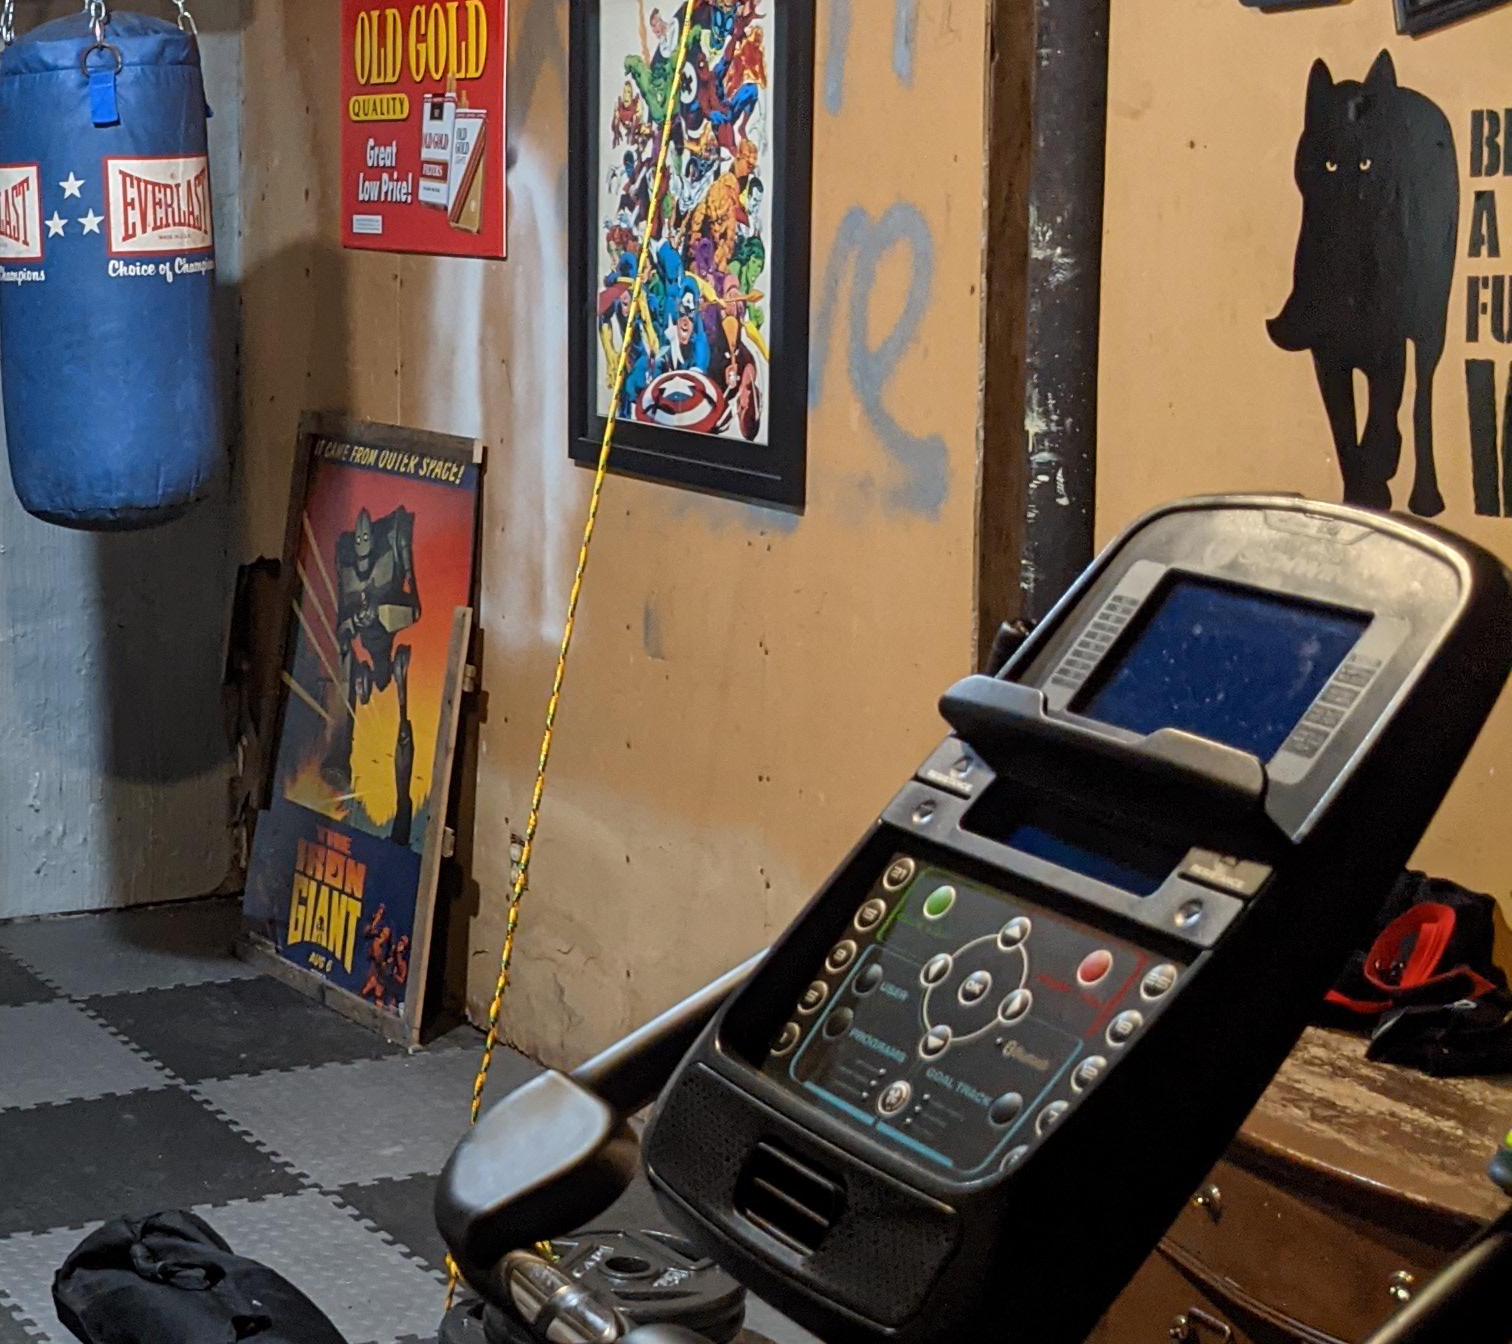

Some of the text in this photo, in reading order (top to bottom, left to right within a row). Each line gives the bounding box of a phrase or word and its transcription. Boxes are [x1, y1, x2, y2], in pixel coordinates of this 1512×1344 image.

[354, 0, 488, 85] OLD GOLD
[352, 96, 406, 117] QUALITY
[366, 138, 397, 168] Great
[119, 165, 209, 243] EVERLAST
[359, 172, 413, 204] Low Price!
[1467, 190, 1501, 258] A
[108, 259, 155, 277] Choice
[158, 262, 174, 284] of
[350, 445, 378, 466] FROM
[419, 457, 465, 485] SPACE!
[295, 837, 368, 899] IRON
[287, 872, 363, 975] GIANT
[965, 979, 985, 996] OK
